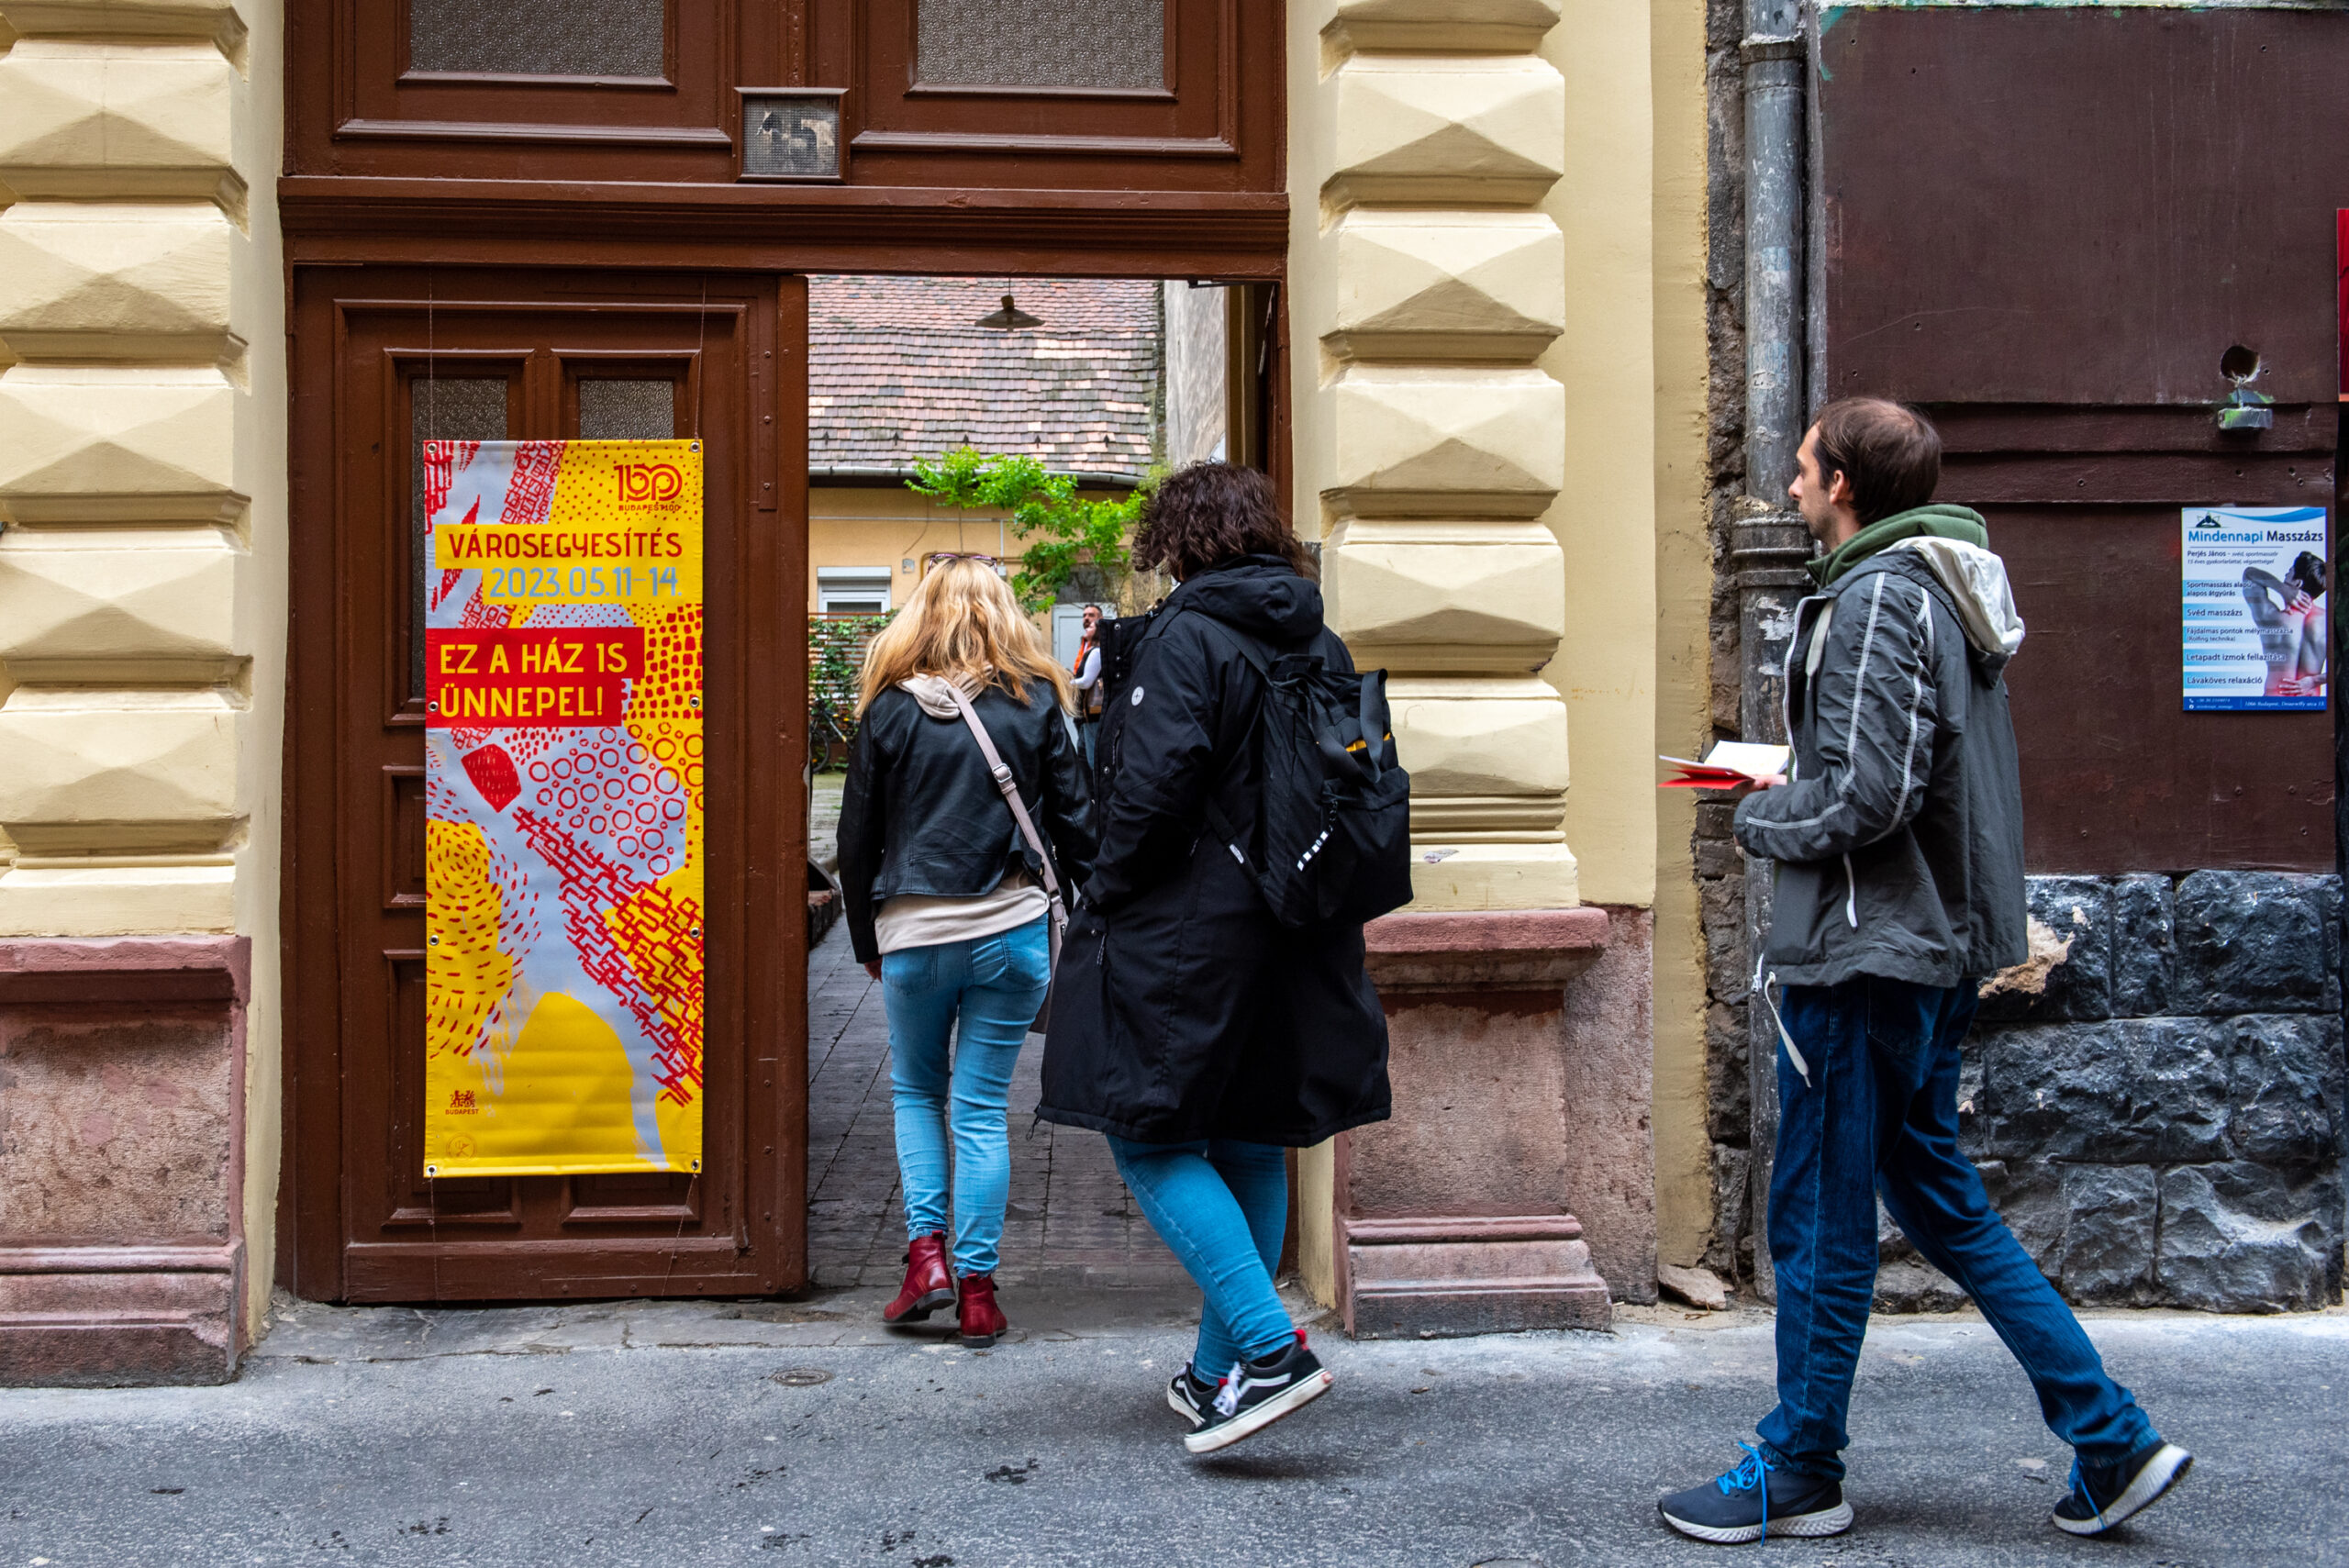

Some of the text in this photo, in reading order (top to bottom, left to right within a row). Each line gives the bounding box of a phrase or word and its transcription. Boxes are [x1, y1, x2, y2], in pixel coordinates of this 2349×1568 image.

[2188, 530, 2324, 544] Mindennapi Masszázs
[448, 527, 684, 559] VÁROSEGYESÍTÉS
[2187, 608, 2243, 617] Svéd masszázs
[2187, 627, 2219, 635] Fájdalmas
[440, 637, 628, 674] EZ A HÁZ IS
[2187, 653, 2220, 662] Letapadt
[2187, 676, 2263, 684] Lávaköves relaxáció
[440, 683, 604, 717] ÜNNEPEL!
